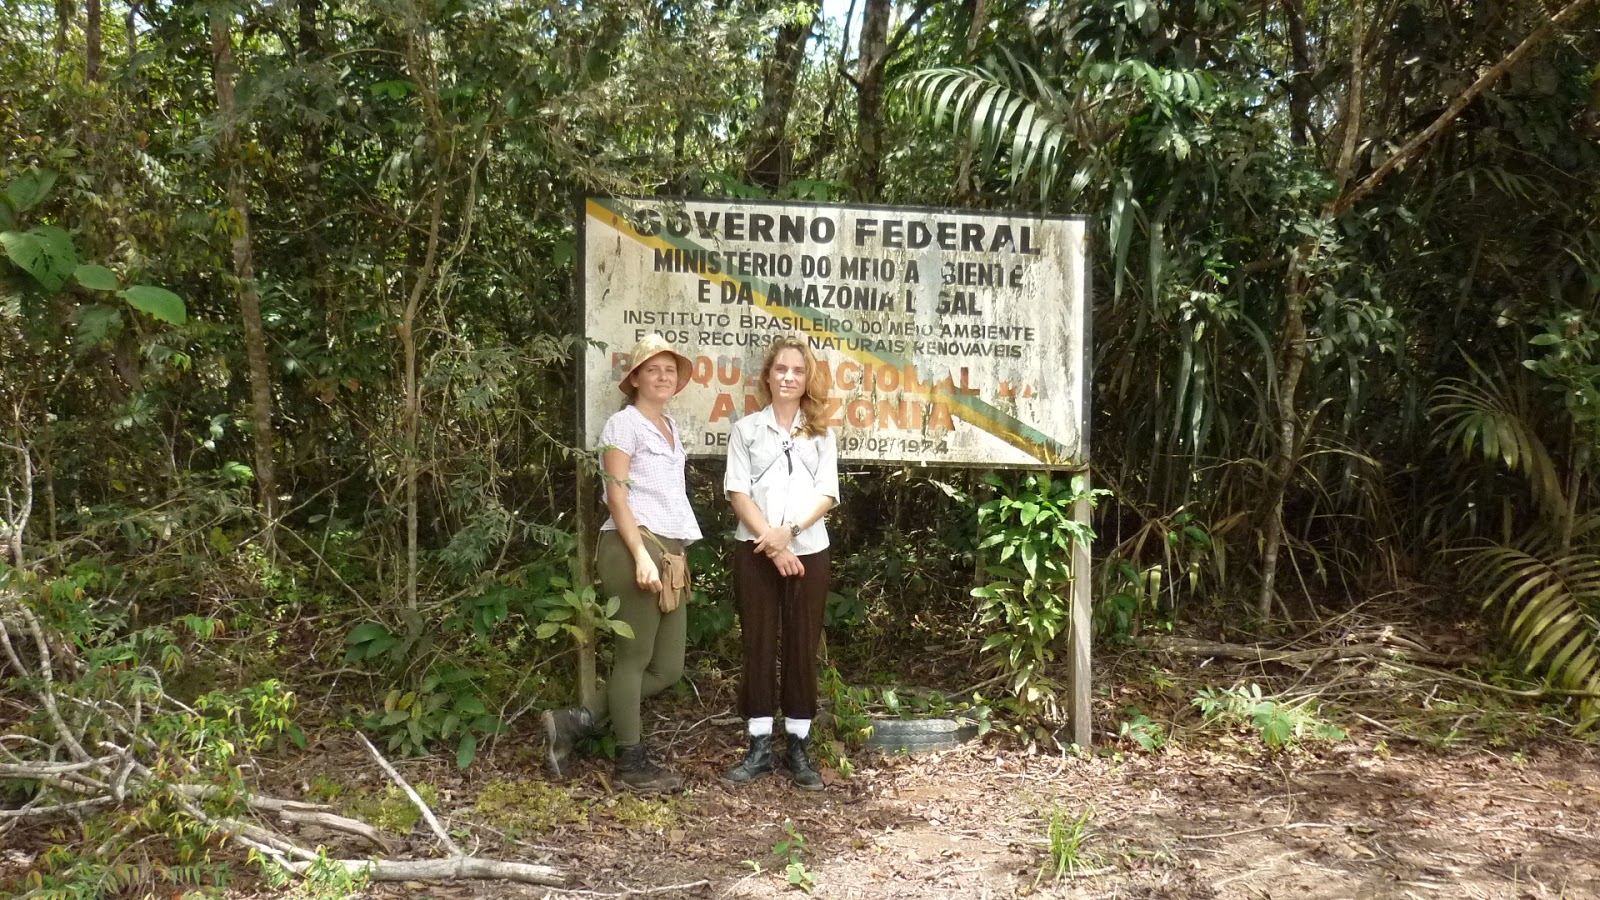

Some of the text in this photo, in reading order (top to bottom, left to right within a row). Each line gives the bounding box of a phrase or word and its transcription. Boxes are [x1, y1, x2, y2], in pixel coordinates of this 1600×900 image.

[634, 208, 1041, 255] GOVERNO FEDERAL
[654, 247, 793, 278] MINISTÉRIO
[801, 254, 832, 279] DO
[905, 259, 1024, 288] ABIENTE
[698, 279, 983, 316] E DA AMAZÔNIA LGAL
[623, 310, 1035, 341] INSTITUTO BRASILEIRO DO MEIO AMBIENTE
[699, 330, 797, 347] RECURS
[808, 335, 905, 354] NATURAIS
[840, 437, 949, 454] 19/02/1974
